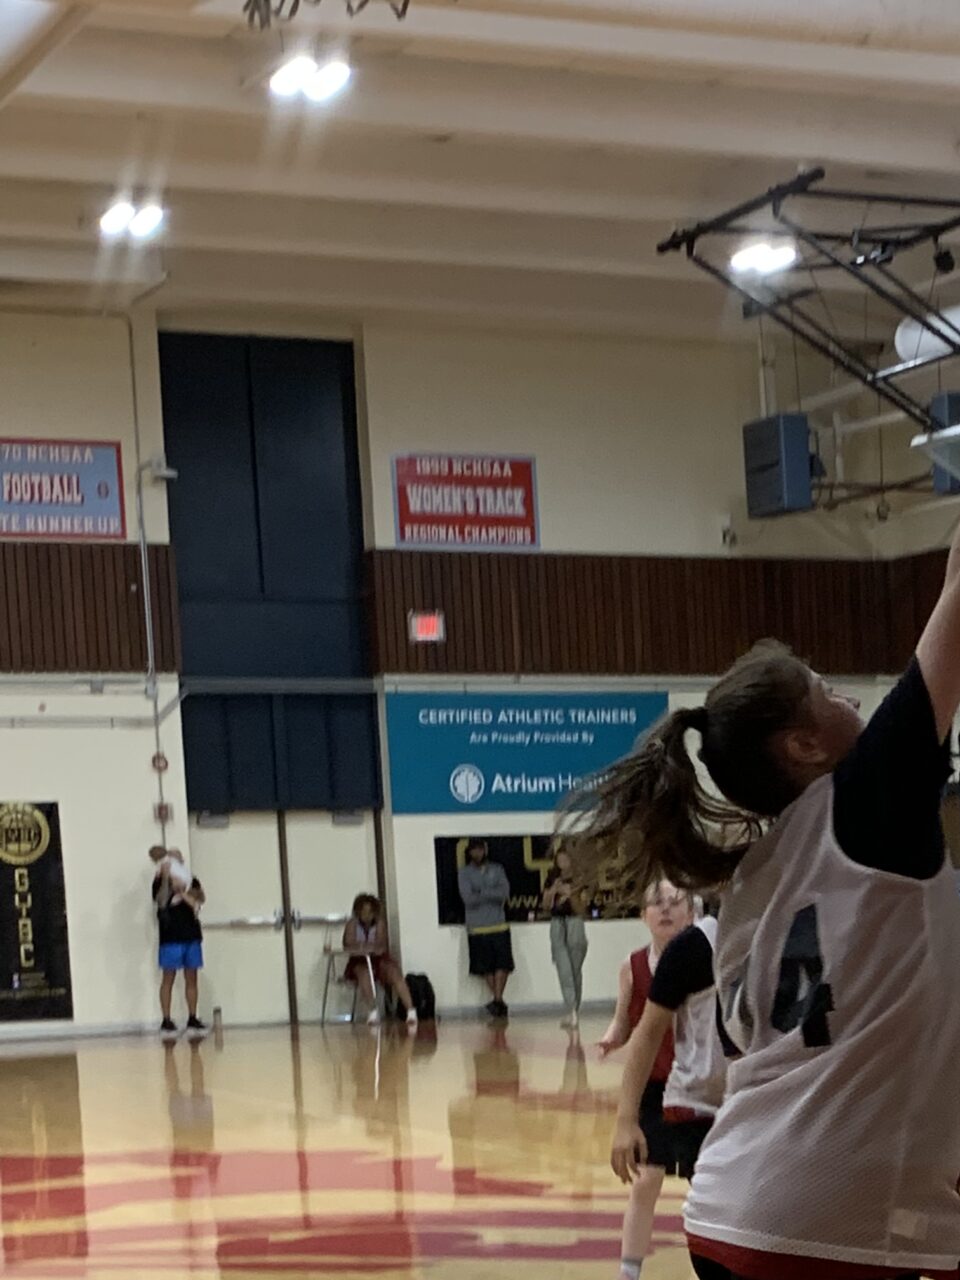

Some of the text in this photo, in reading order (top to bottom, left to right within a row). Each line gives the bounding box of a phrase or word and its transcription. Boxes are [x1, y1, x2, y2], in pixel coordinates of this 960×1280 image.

[2, 473, 84, 505] FOOTBALL
[477, 487, 525, 516] TRACK
[26, 513, 94, 534] RUNNER
[404, 522, 532, 545] REGIONAL CHAMPIONS
[418, 708, 637, 725] CERTIFIED ATHLETIC TRAINERS
[469, 731, 595, 747] Are Proudly Provided By
[490, 772, 556, 794] Atrium
